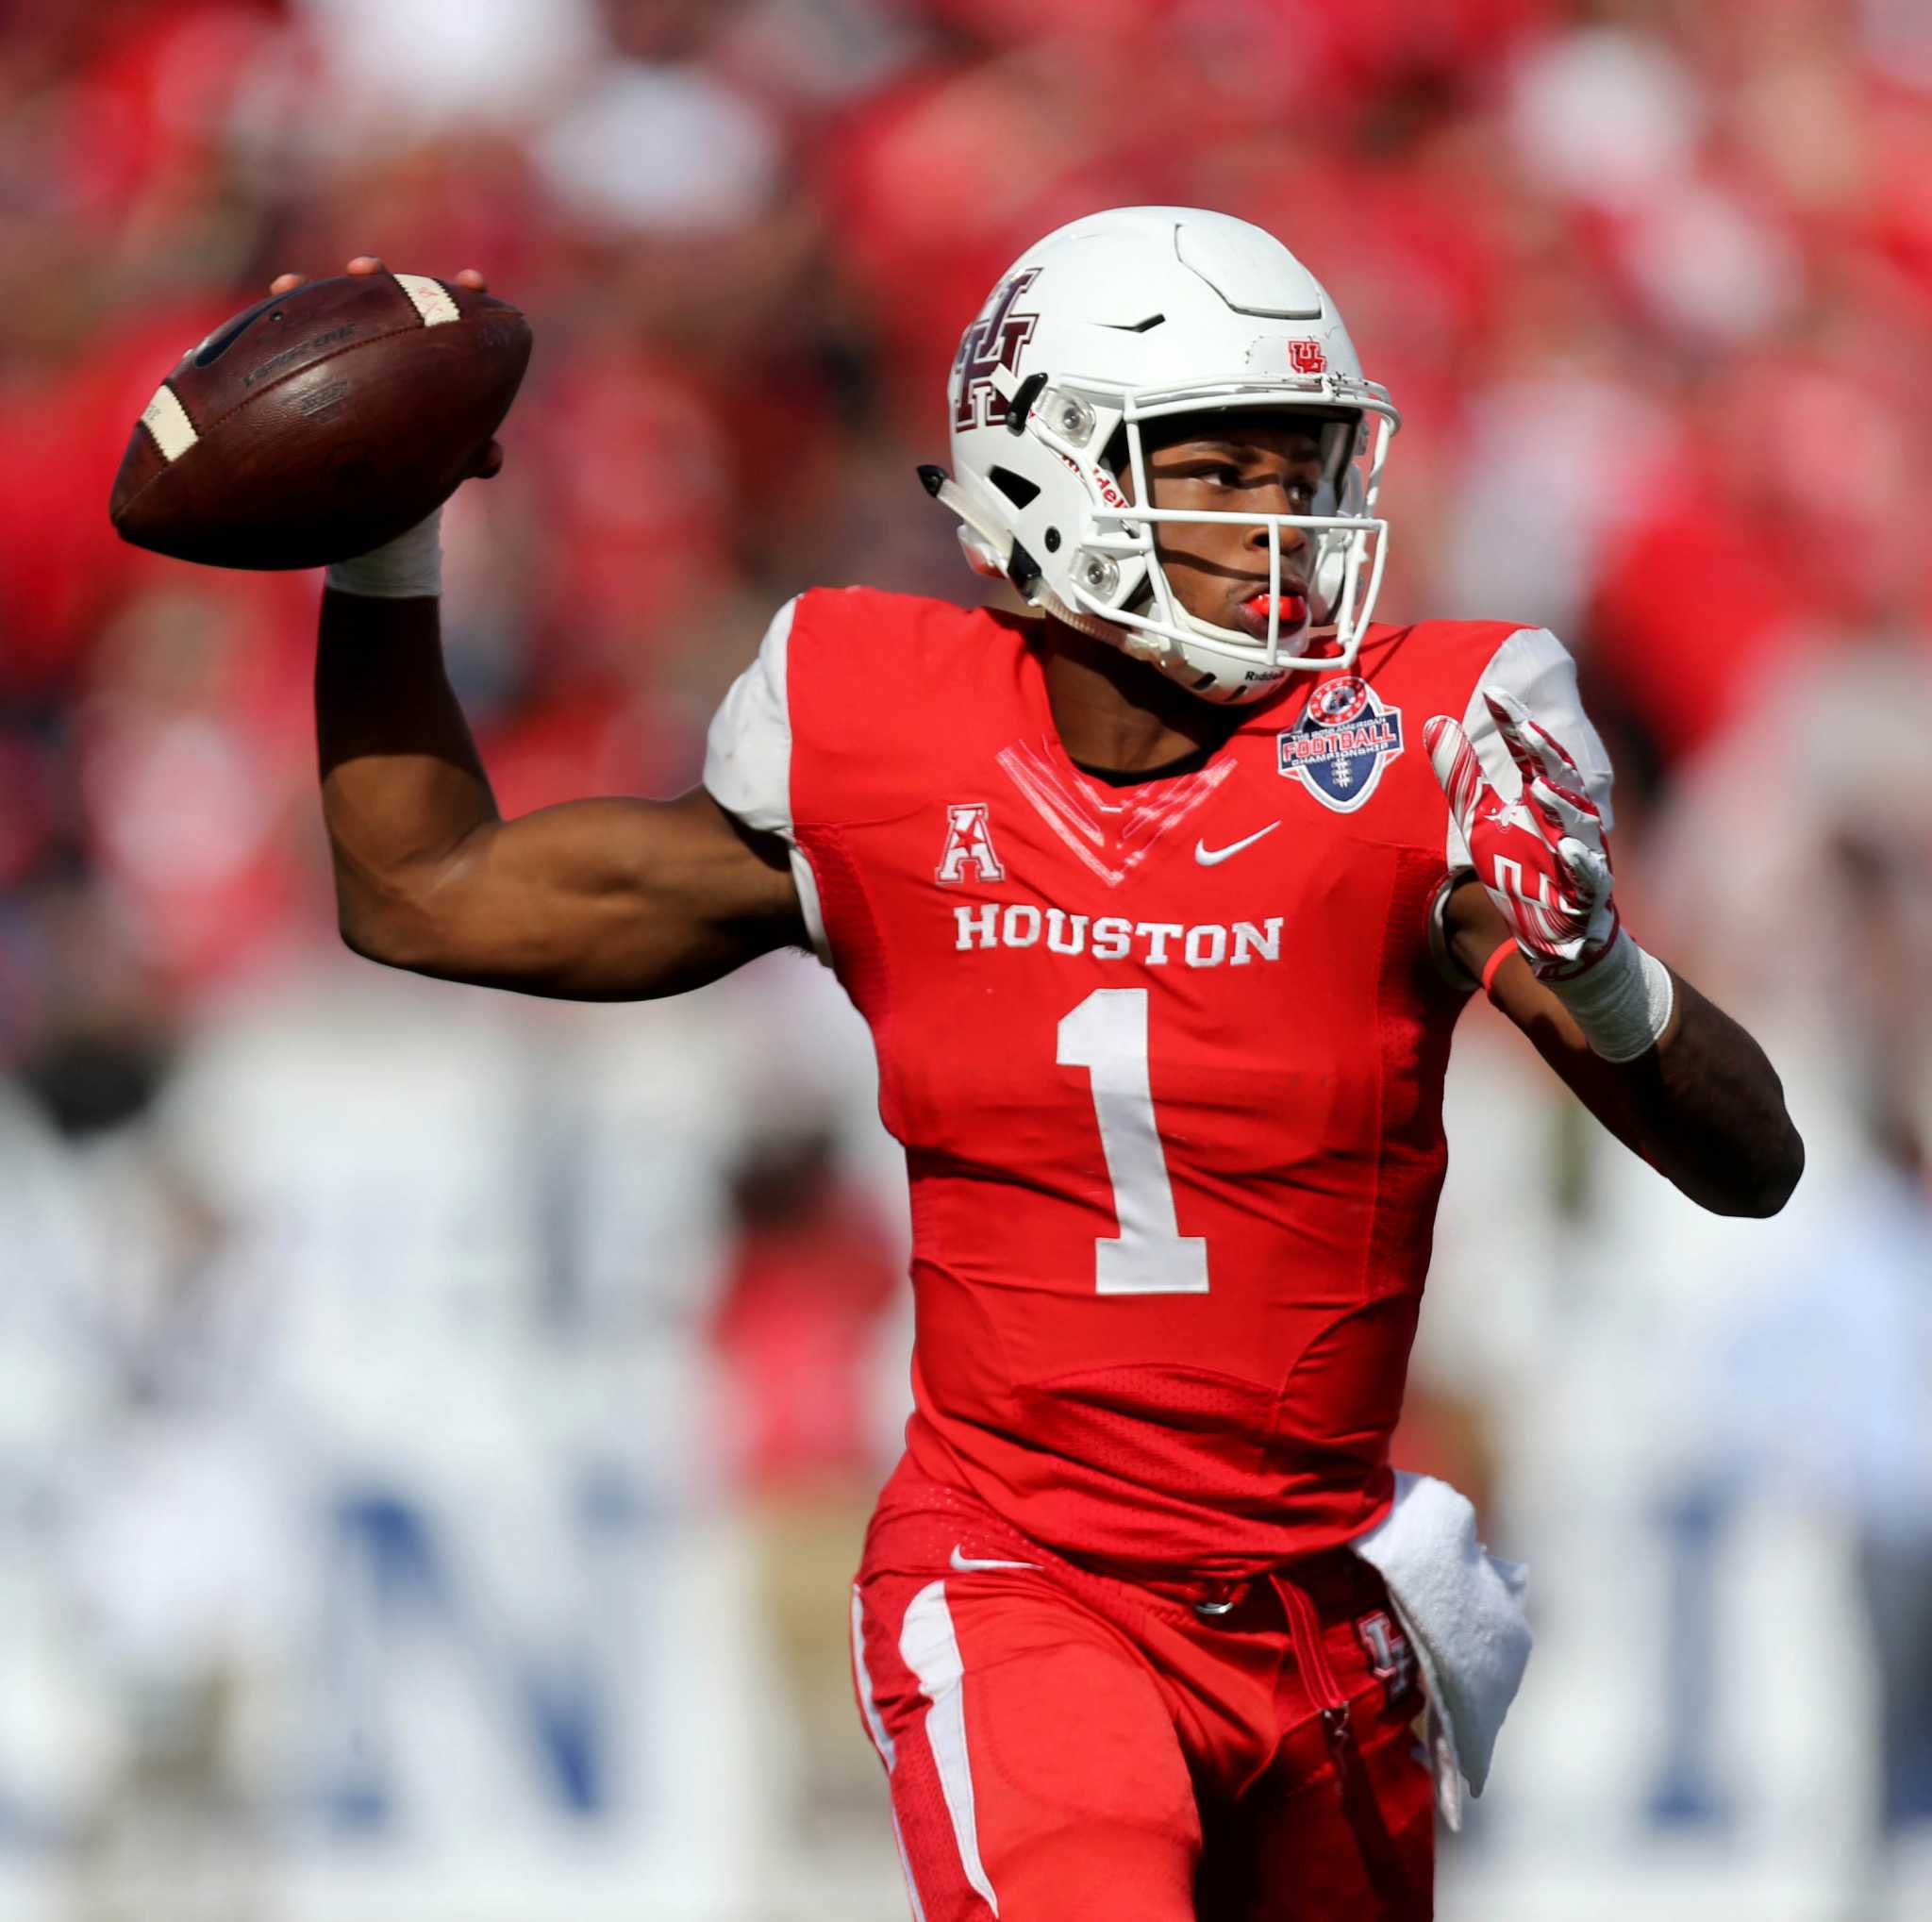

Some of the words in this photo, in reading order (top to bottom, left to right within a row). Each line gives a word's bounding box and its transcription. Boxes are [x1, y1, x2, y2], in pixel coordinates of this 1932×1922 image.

[1282, 722, 1397, 762] FOOTBALL
[1291, 742, 1390, 766] CHAMPIONSHIP
[954, 903, 1284, 968] HOUSTON
[1056, 988, 1208, 1295] 1
